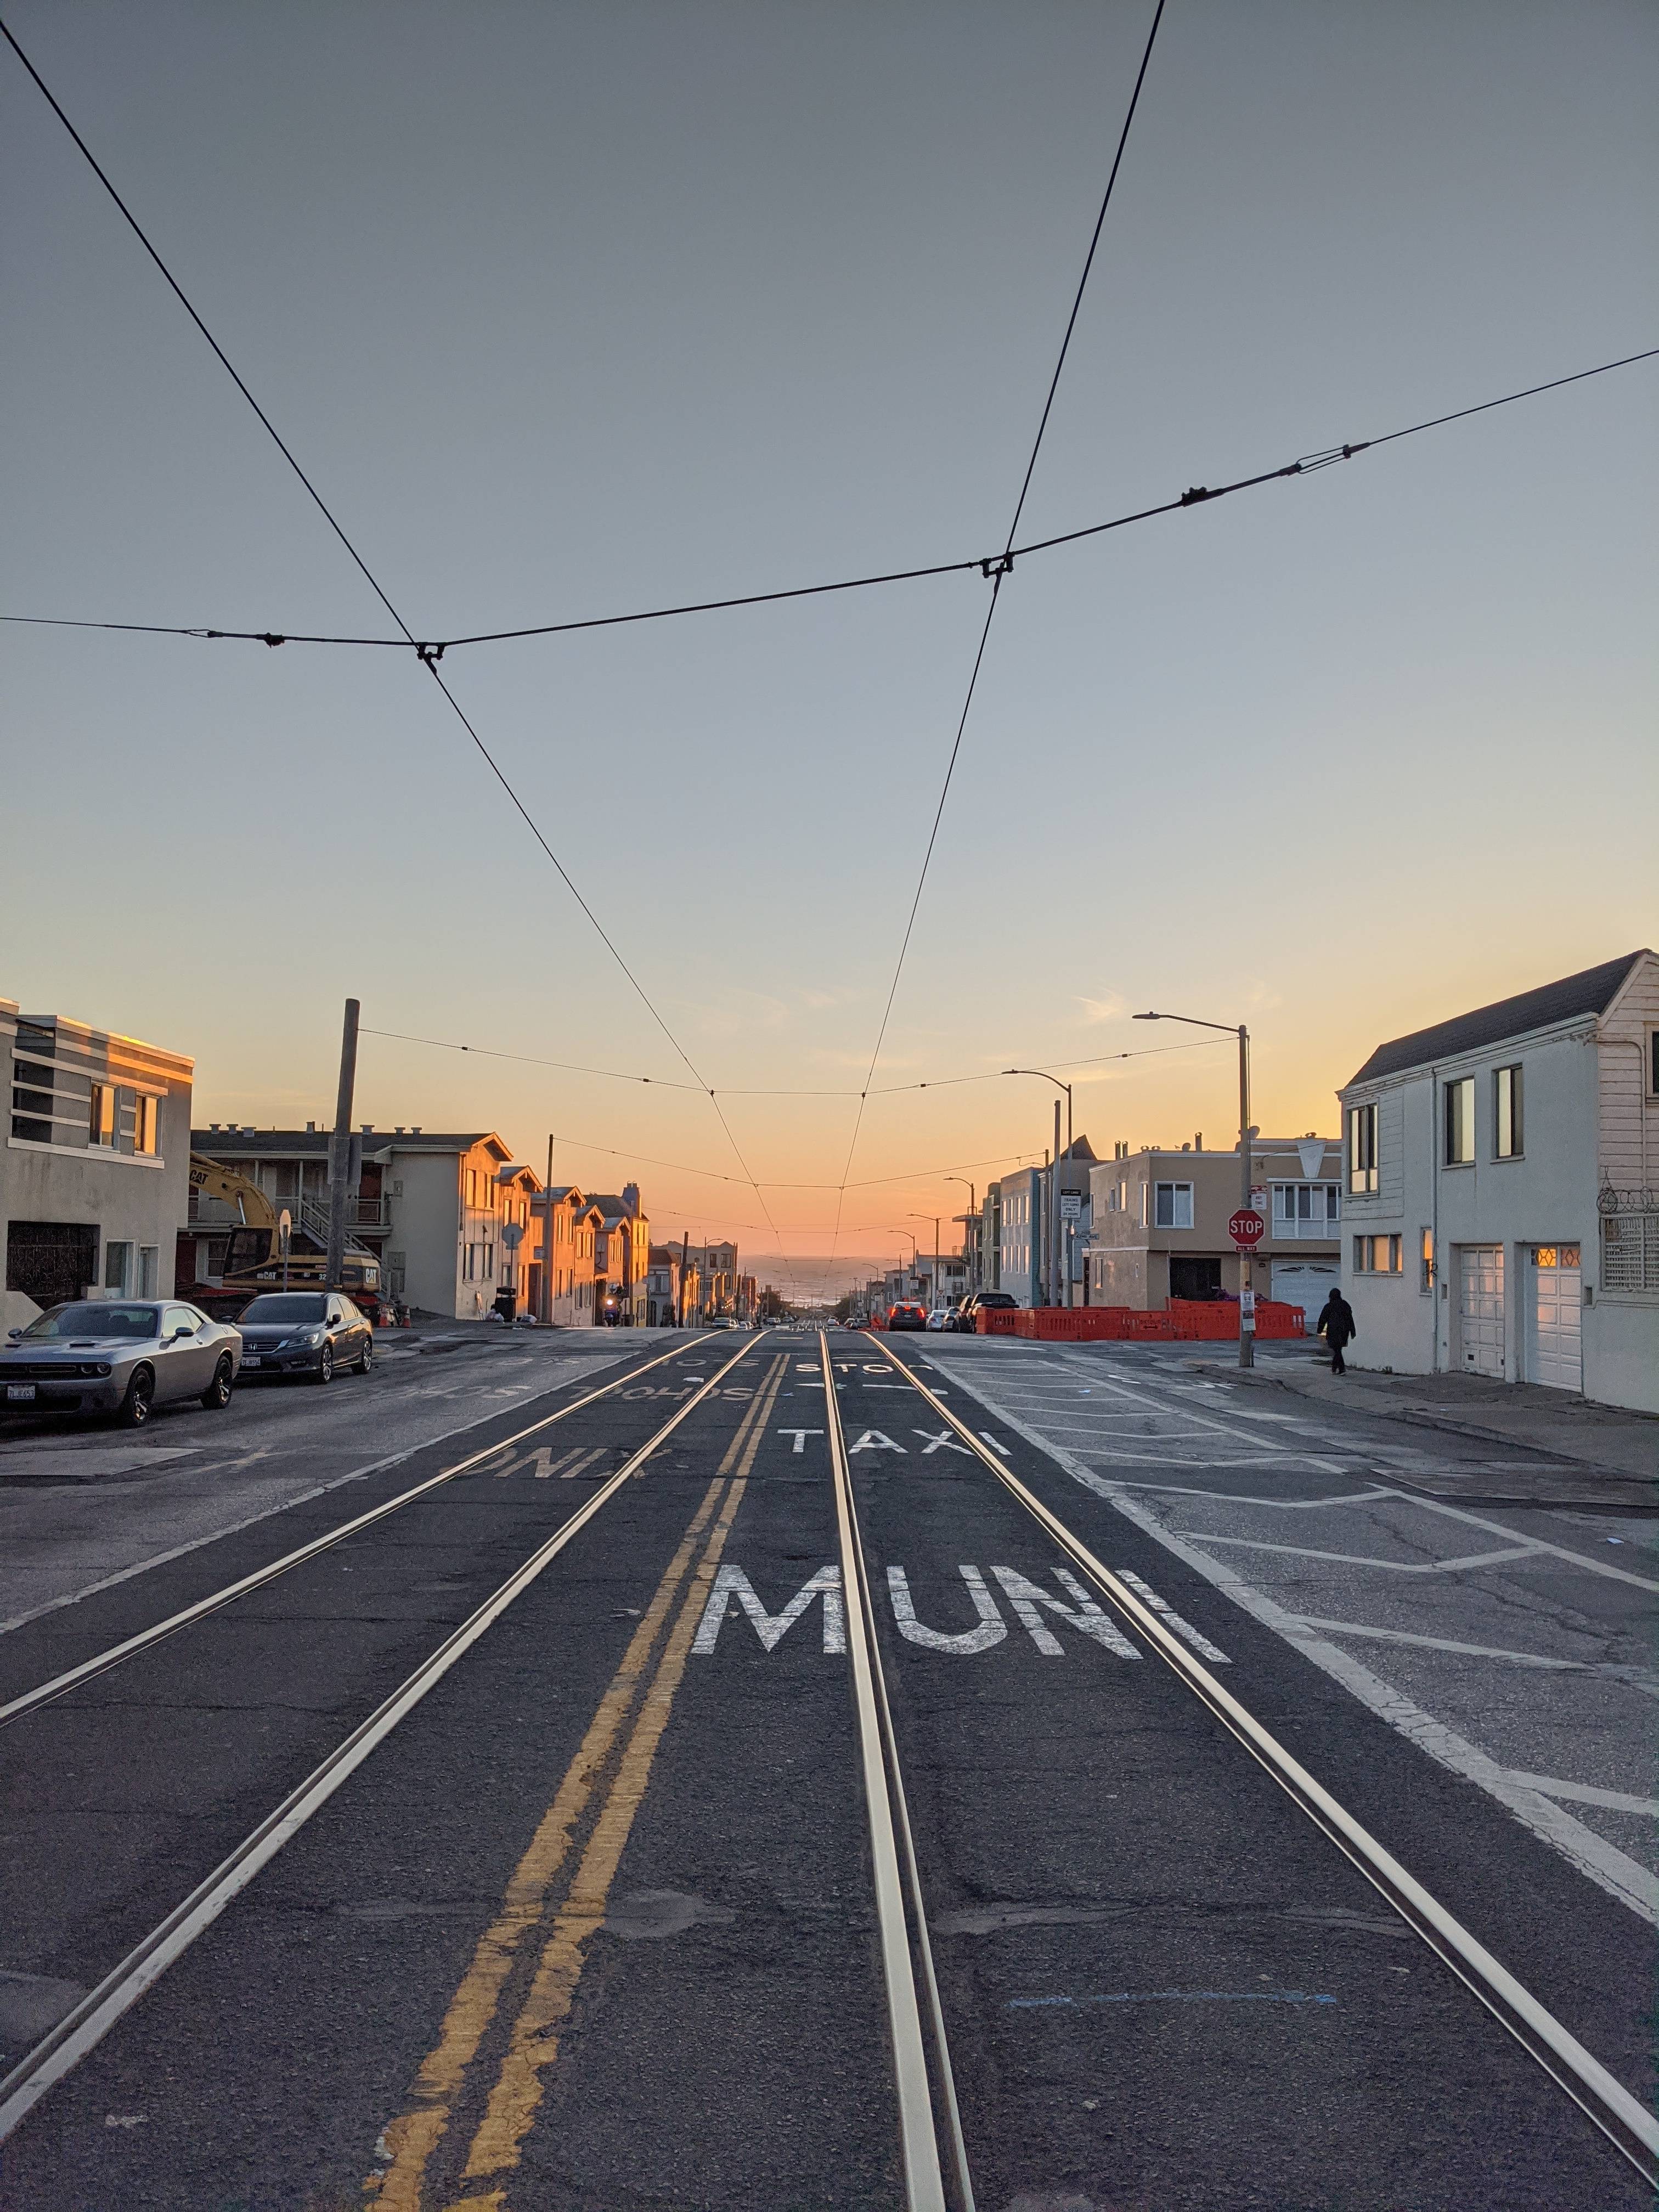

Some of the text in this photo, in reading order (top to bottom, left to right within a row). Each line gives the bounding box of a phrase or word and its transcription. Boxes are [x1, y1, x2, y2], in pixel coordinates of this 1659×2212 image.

[189, 1170, 208, 1184] CAT
[1231, 1220, 1262, 1234] STOP
[264, 1272, 276, 1280] CAT
[365, 1268, 377, 1284] CAT
[777, 1429, 1013, 1456] TAXI
[691, 1564, 1233, 1663] MUNI
